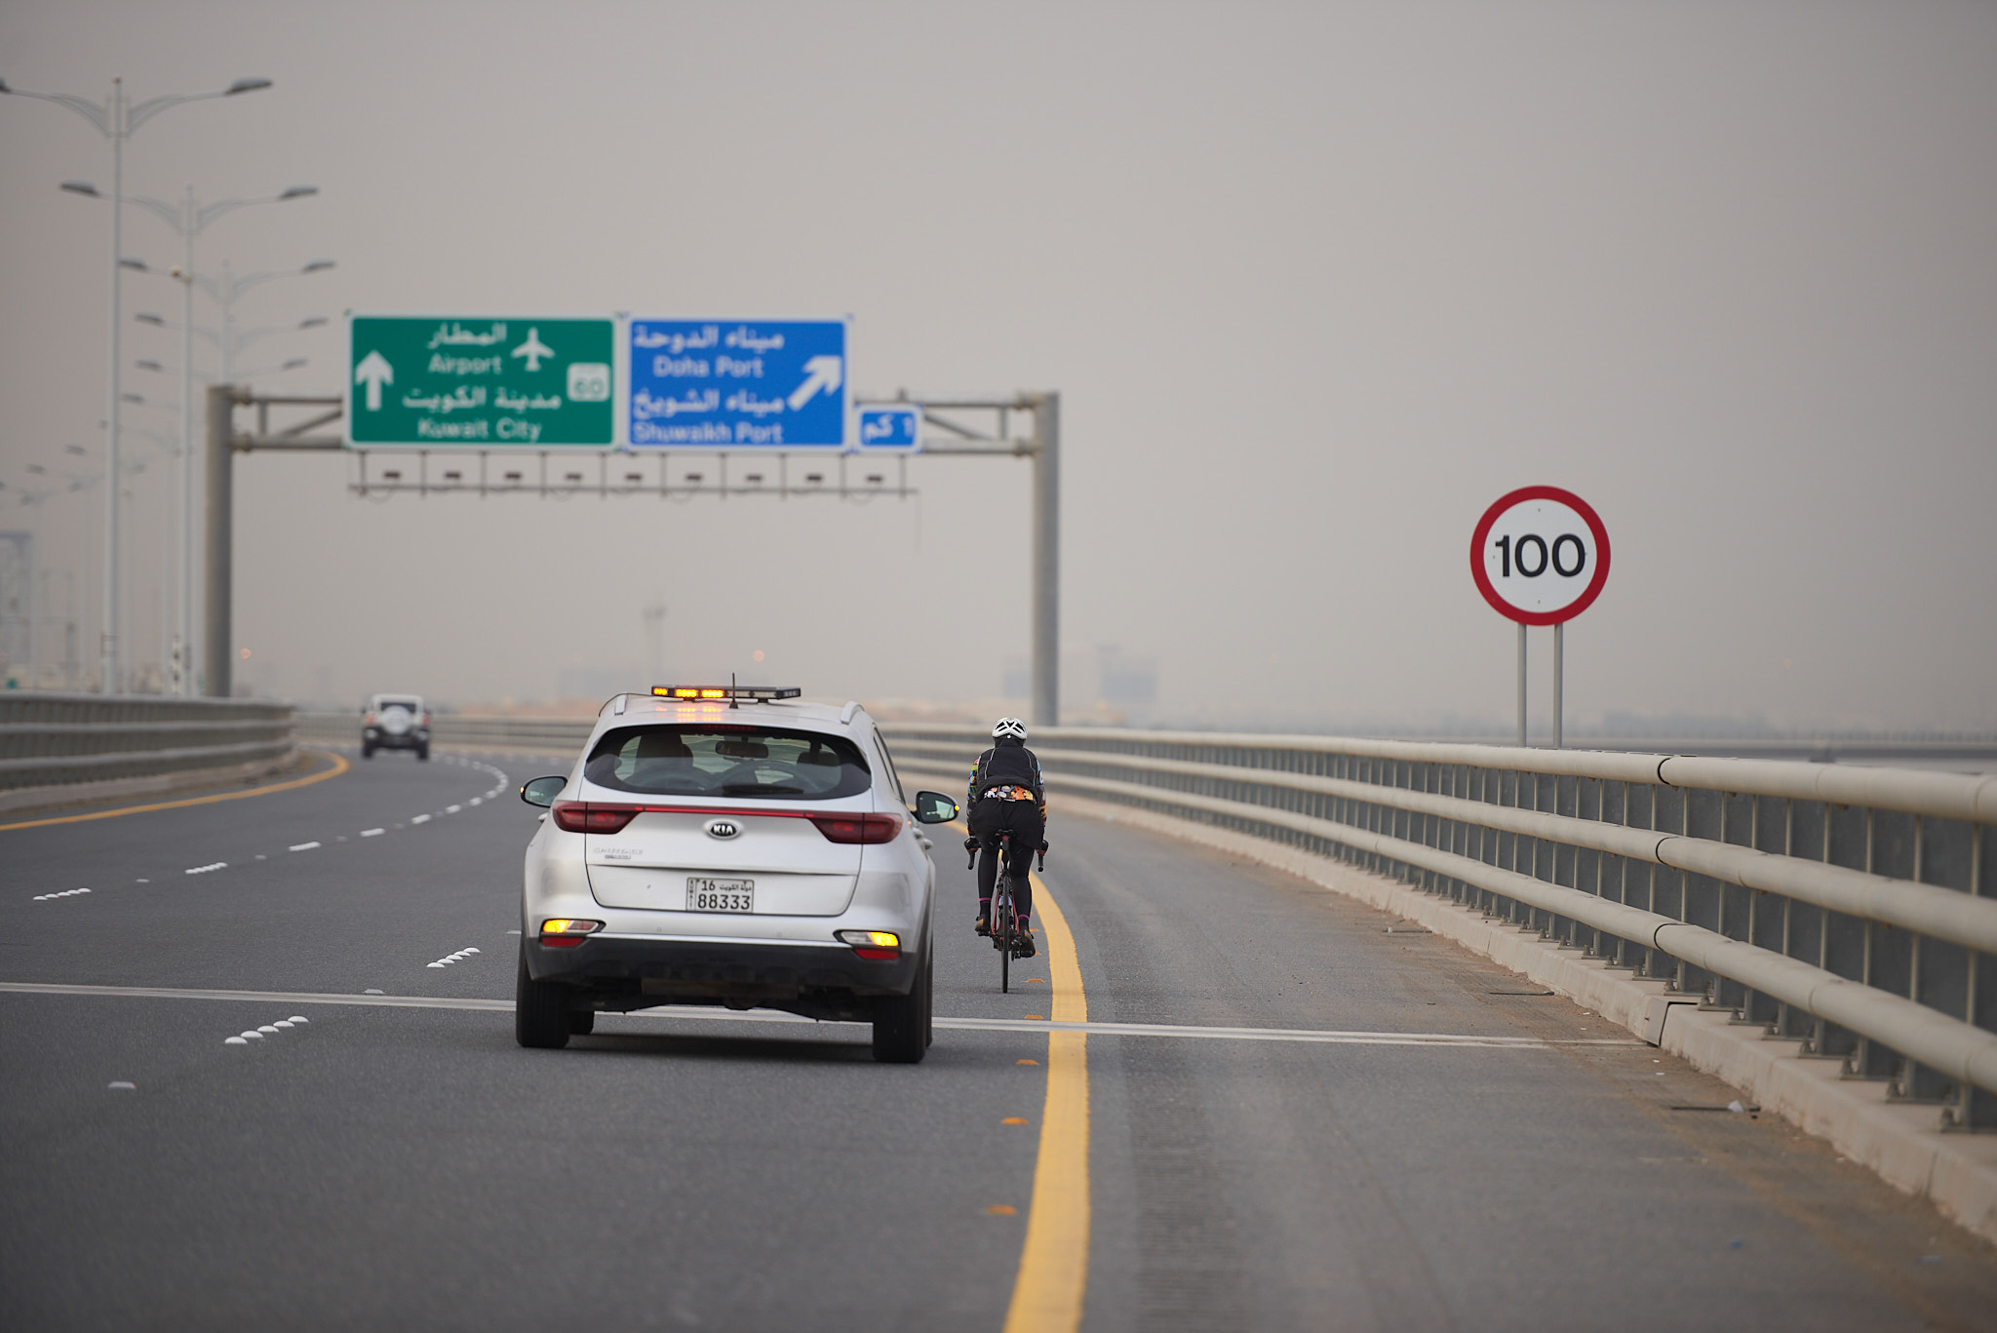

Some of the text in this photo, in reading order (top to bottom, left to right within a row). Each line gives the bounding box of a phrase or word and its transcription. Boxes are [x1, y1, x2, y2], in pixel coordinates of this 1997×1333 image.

[426, 322, 507, 350] المطار
[633, 325, 785, 354] ميناء الدوحة
[428, 353, 502, 375] Airport
[653, 355, 765, 378] Doha Port
[402, 385, 562, 414] مدينة الكويت
[725, 389, 785, 418] ميناء
[417, 417, 542, 442] Kuwait City
[633, 421, 784, 444] Shuwaikh Port
[1495, 533, 1586, 578] 100
[713, 824, 734, 834] KIA
[702, 880, 715, 891] 16
[697, 893, 750, 910] 88333
